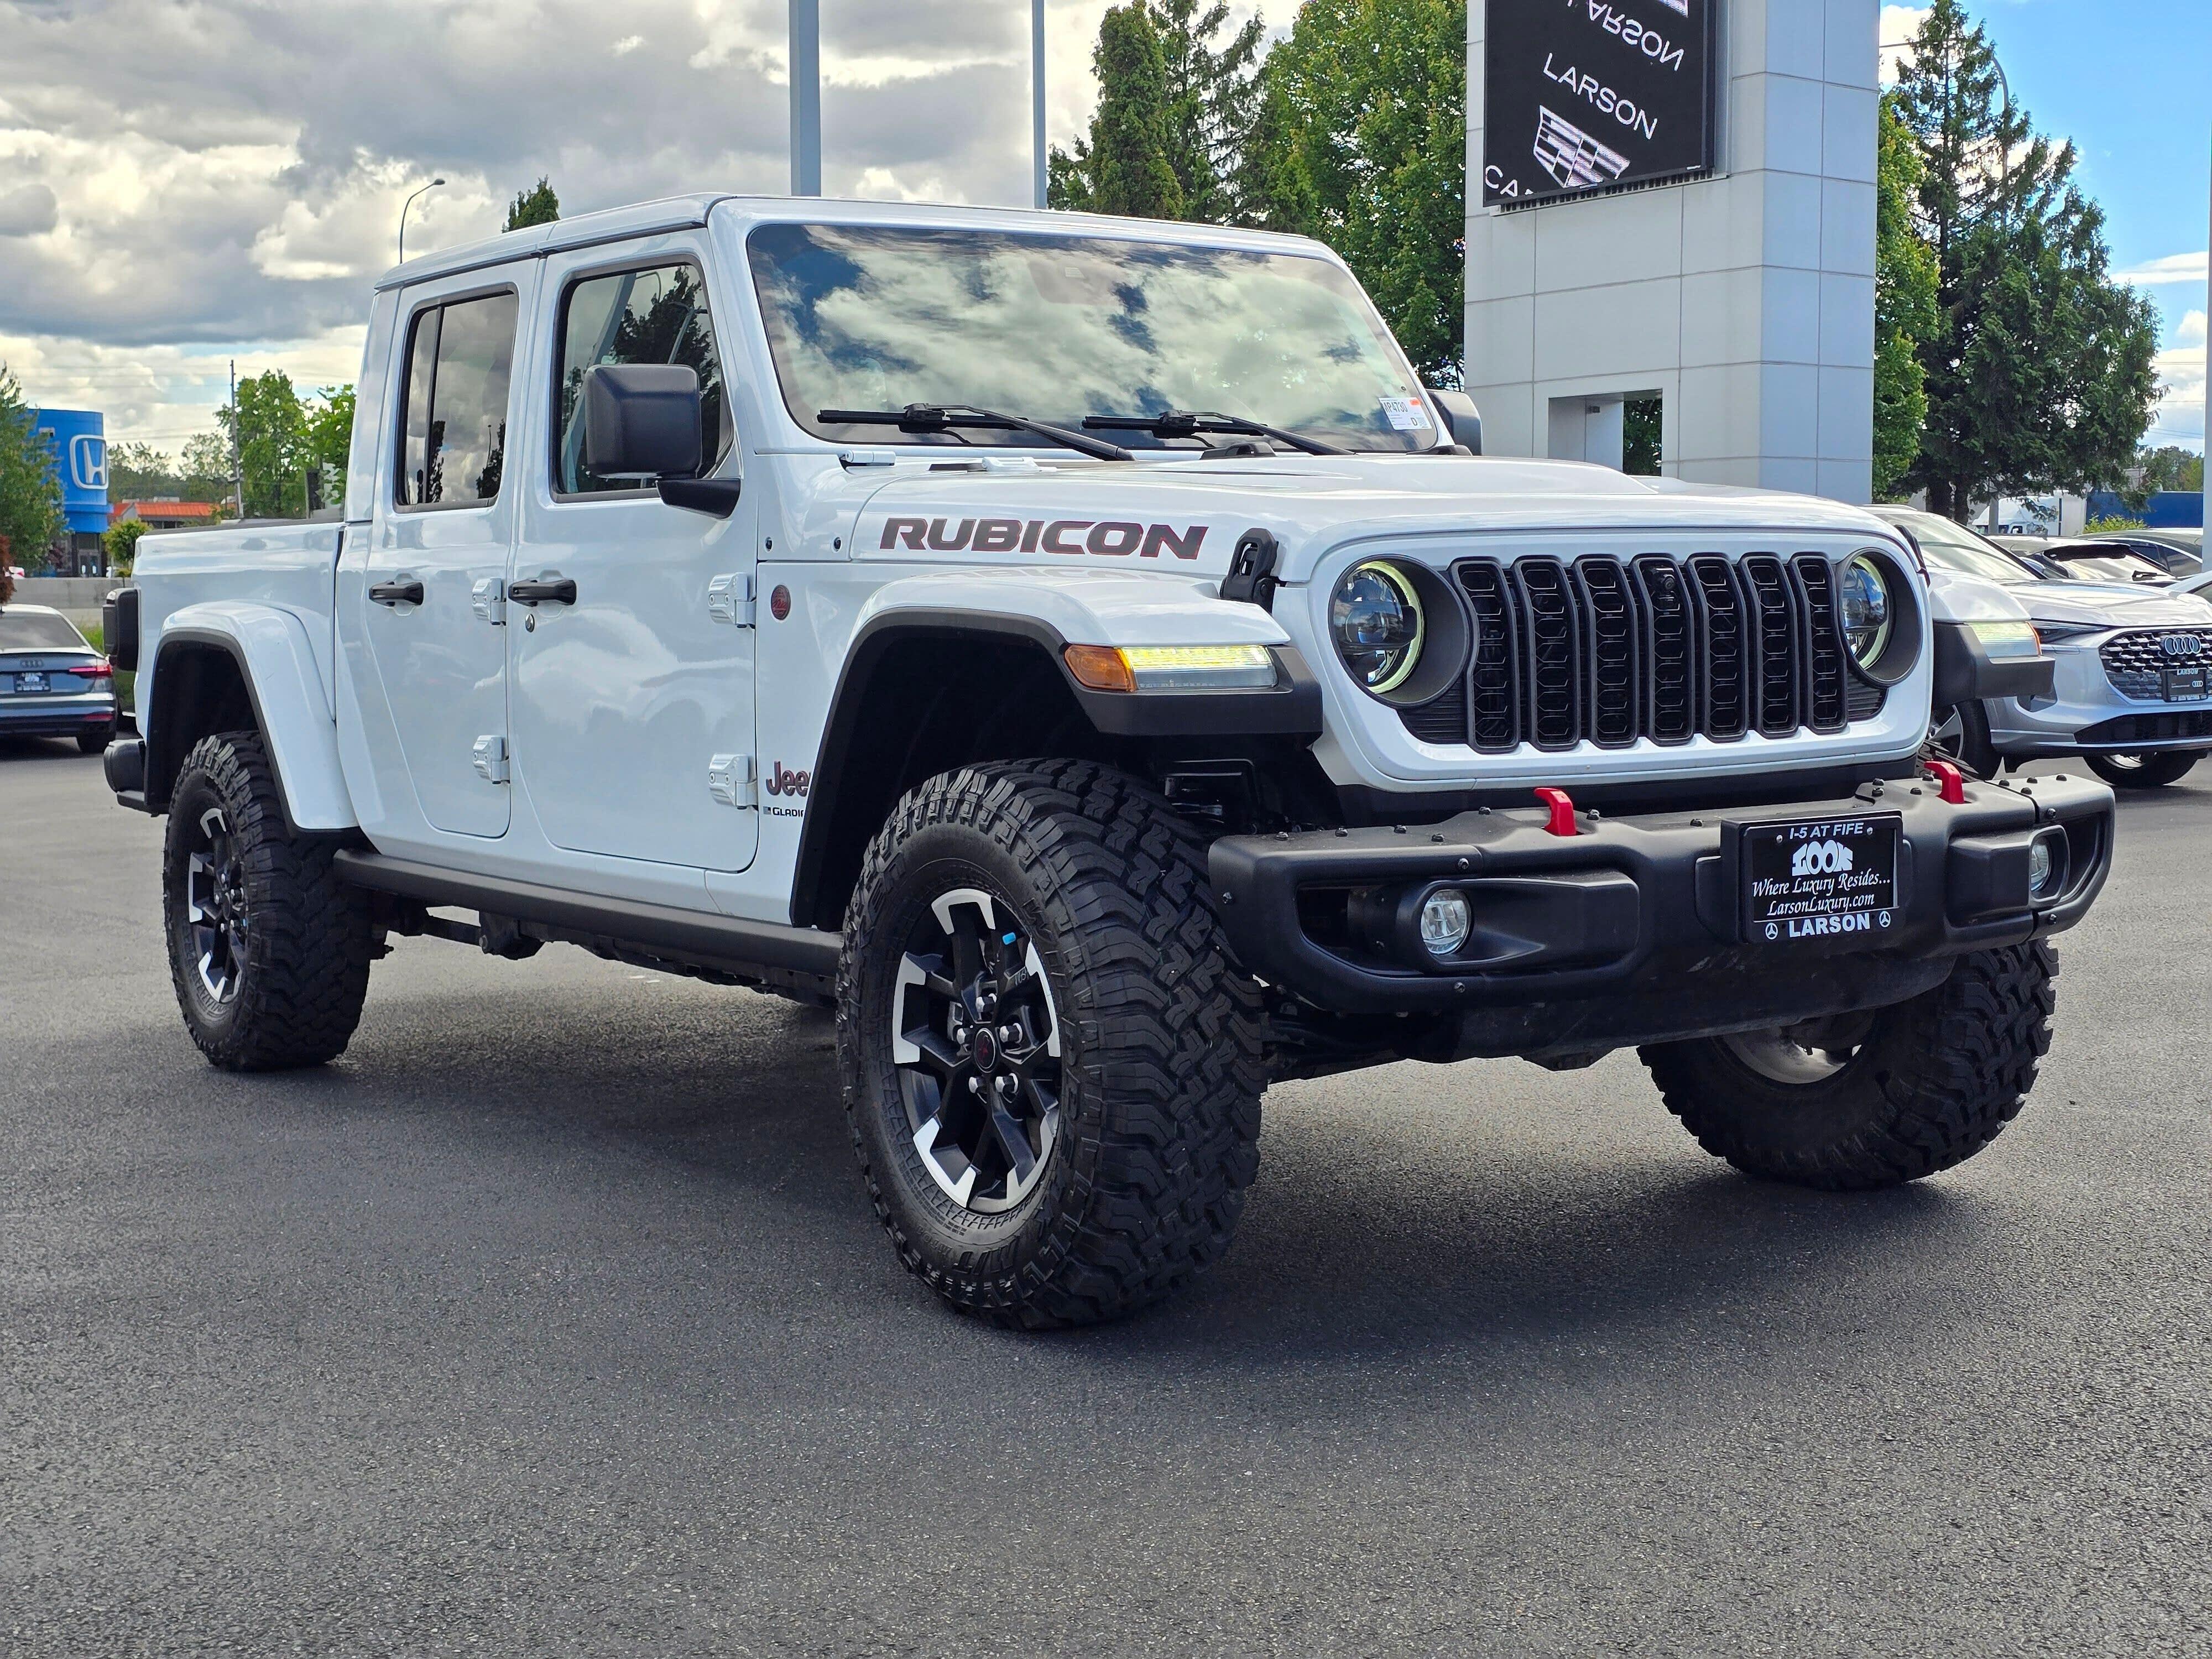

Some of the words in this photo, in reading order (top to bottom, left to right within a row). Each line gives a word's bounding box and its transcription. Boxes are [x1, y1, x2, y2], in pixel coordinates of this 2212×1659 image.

[1543, 53, 1657, 140] LARSON
[1485, 165, 1533, 197] CA
[880, 518, 1209, 560] RUBICON
[766, 761, 811, 797] Jee
[1790, 827, 1807, 839] I-5
[1809, 826, 1829, 838] AT
[1833, 822, 1864, 835] FIFE
[1751, 878, 1789, 897] Where
[1792, 875, 1834, 897] Luxury
[1837, 868, 1891, 890] Resides...
[1767, 894, 1875, 916] LarsonLuxury.com
[1789, 912, 1871, 937] LARSON
